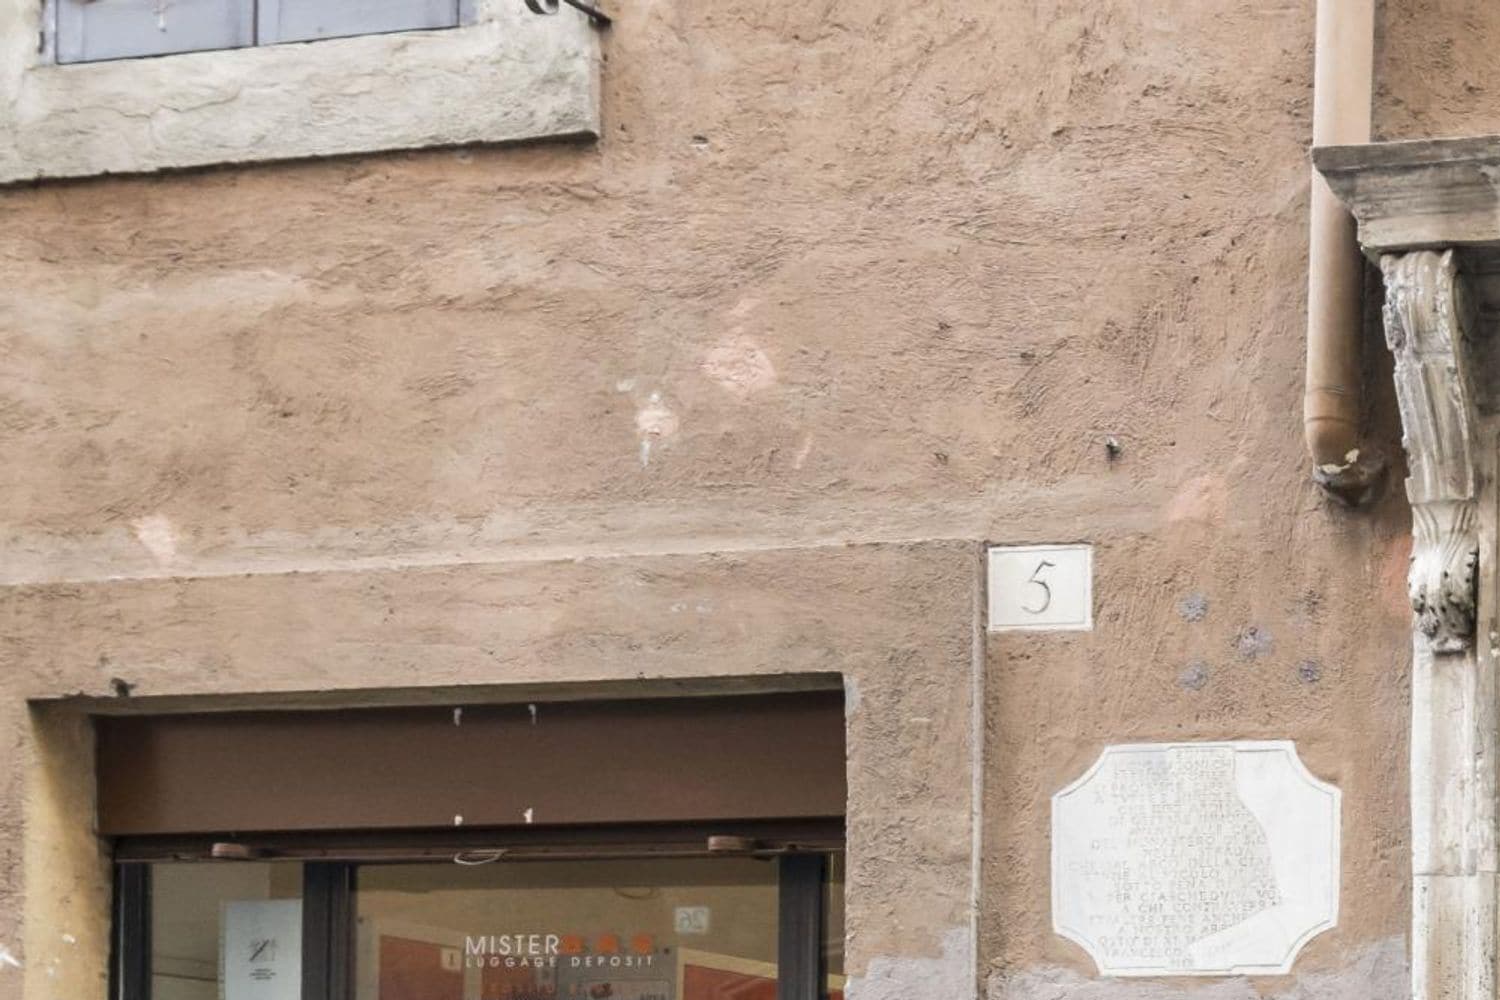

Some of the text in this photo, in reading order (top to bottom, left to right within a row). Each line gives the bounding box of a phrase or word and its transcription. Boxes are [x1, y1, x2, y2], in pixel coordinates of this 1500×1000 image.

[1021, 560, 1056, 615] 5
[465, 935, 560, 955] MISTER
[465, 955, 654, 968] LUGGAGE DEPOSIT
